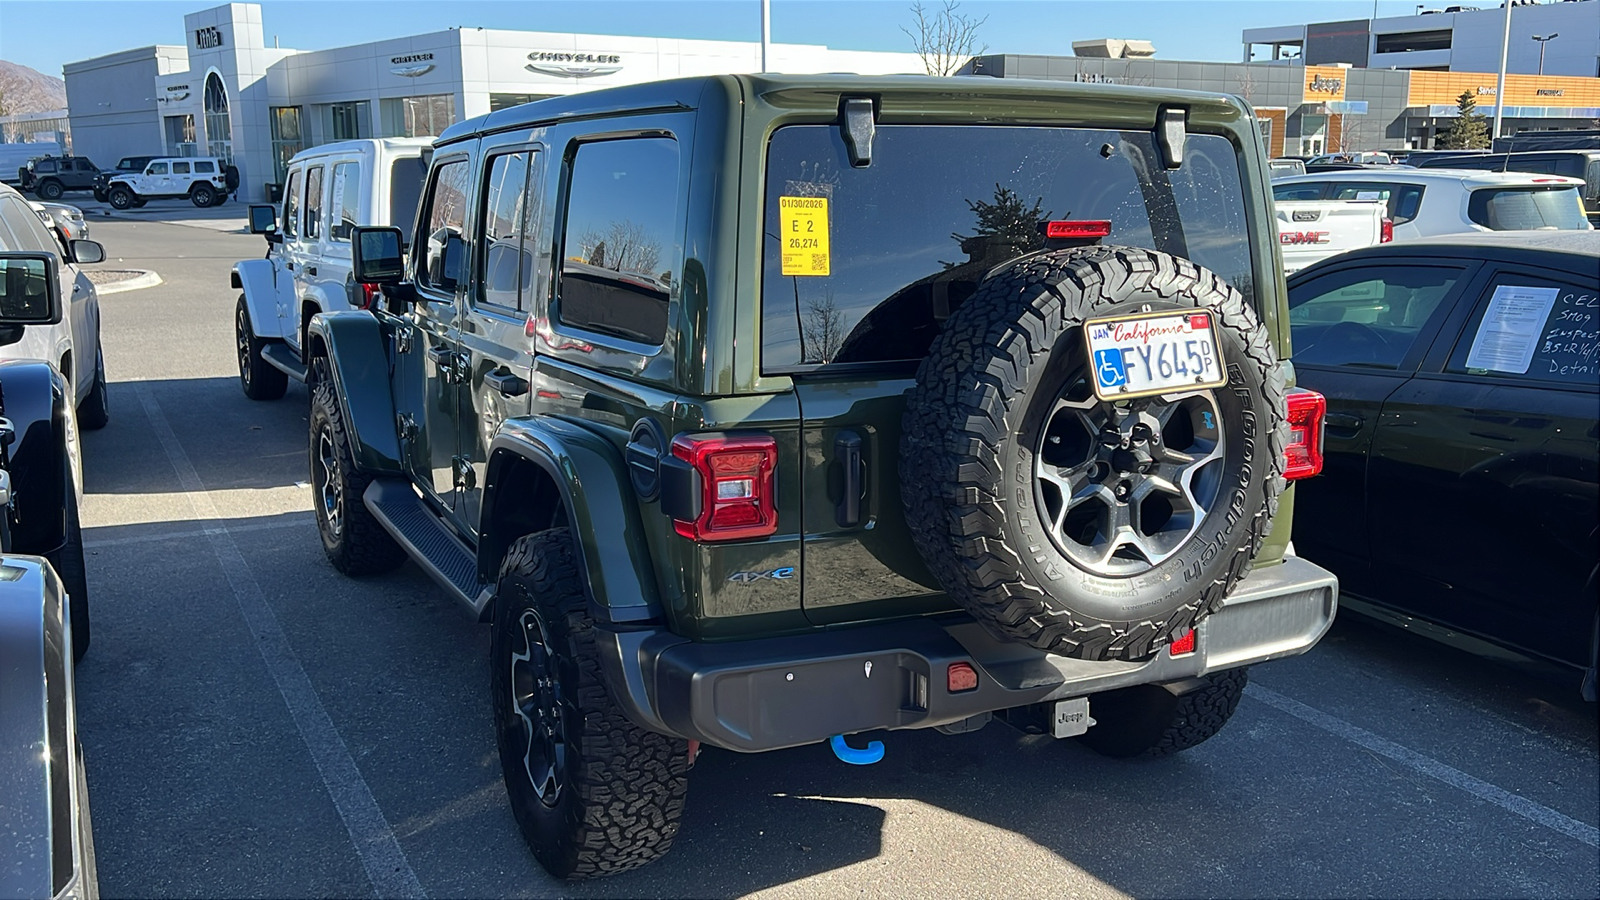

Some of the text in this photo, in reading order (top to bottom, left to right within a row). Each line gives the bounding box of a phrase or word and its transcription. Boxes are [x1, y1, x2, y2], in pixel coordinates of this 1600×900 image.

[196, 26, 223, 49] Lithia
[391, 53, 434, 64] CHRYSLER
[527, 51, 621, 64] CHRYSLER
[1309, 73, 1341, 95] Jeep
[1477, 86, 1497, 96] Servic
[781, 199, 824, 209] 01/30/2026
[792, 220, 814, 232] E 2
[789, 238, 818, 249] 26,274
[1279, 231, 1331, 246] GMC
[1093, 328, 1109, 340] JAN
[1114, 321, 1193, 344] California
[1120, 340, 1204, 384] FY645
[1183, 364, 1257, 582] BFGoodrich
[1016, 446, 1065, 581] All-Terr
[1058, 711, 1084, 724] Jeep
